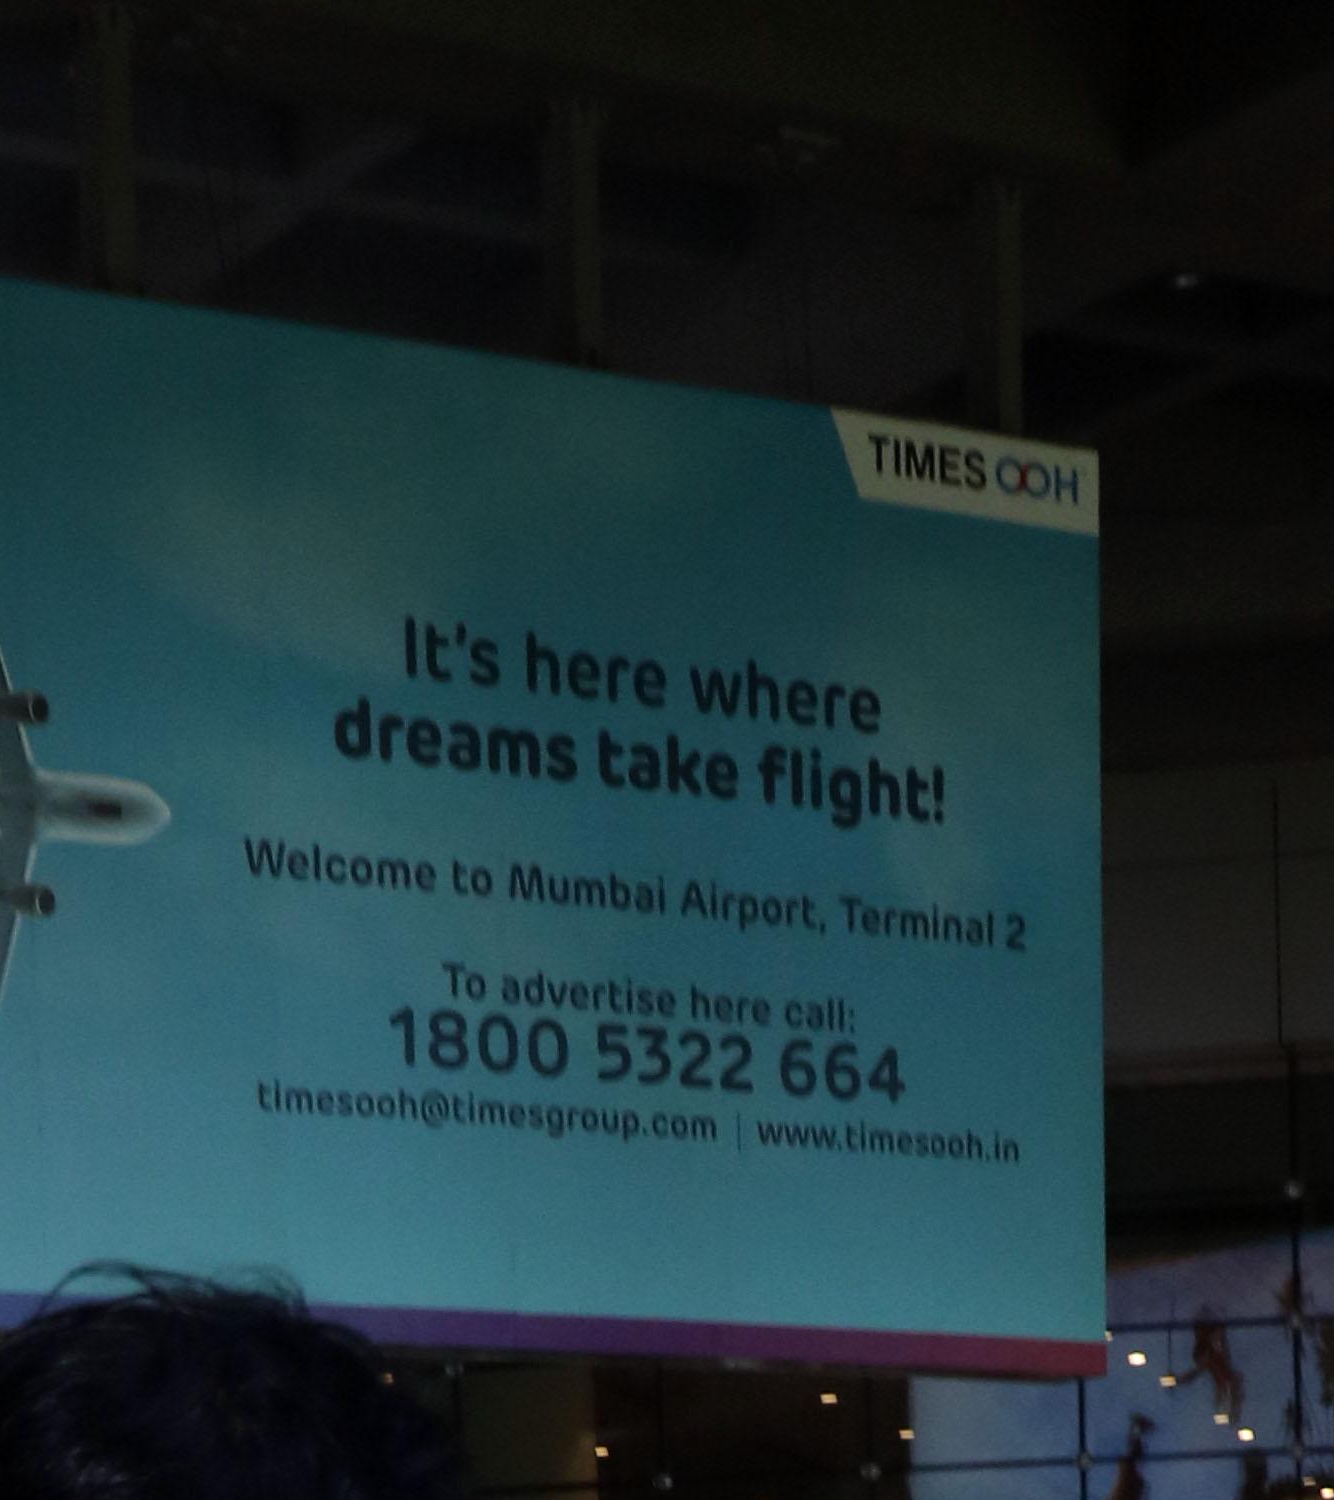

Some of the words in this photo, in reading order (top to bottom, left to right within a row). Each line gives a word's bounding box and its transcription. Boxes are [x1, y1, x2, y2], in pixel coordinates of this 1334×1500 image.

[868, 434, 987, 491] TIMES
[405, 613, 501, 688] It's
[526, 629, 667, 707] here
[690, 657, 882, 735] where
[334, 695, 579, 783] dreams
[597, 727, 739, 800] take
[758, 743, 946, 830] flight!
[244, 834, 436, 892] Welcome
[452, 854, 494, 897] to
[509, 862, 666, 915] Mumbai
[680, 878, 827, 935] Airport,
[839, 893, 995, 948] Terminal
[1005, 911, 1027, 951] 2
[441, 959, 487, 1000] To
[501, 968, 676, 1019] advertise
[689, 982, 771, 1028] here
[783, 994, 857, 1035] call:
[389, 1004, 570, 1080] 1800
[596, 1021, 755, 1095] 5322
[778, 1037, 906, 1104] 664
[256, 1077, 718, 1144] timesooh@timesgroup.com
[757, 1117, 1021, 1165] www.timesooh.in
